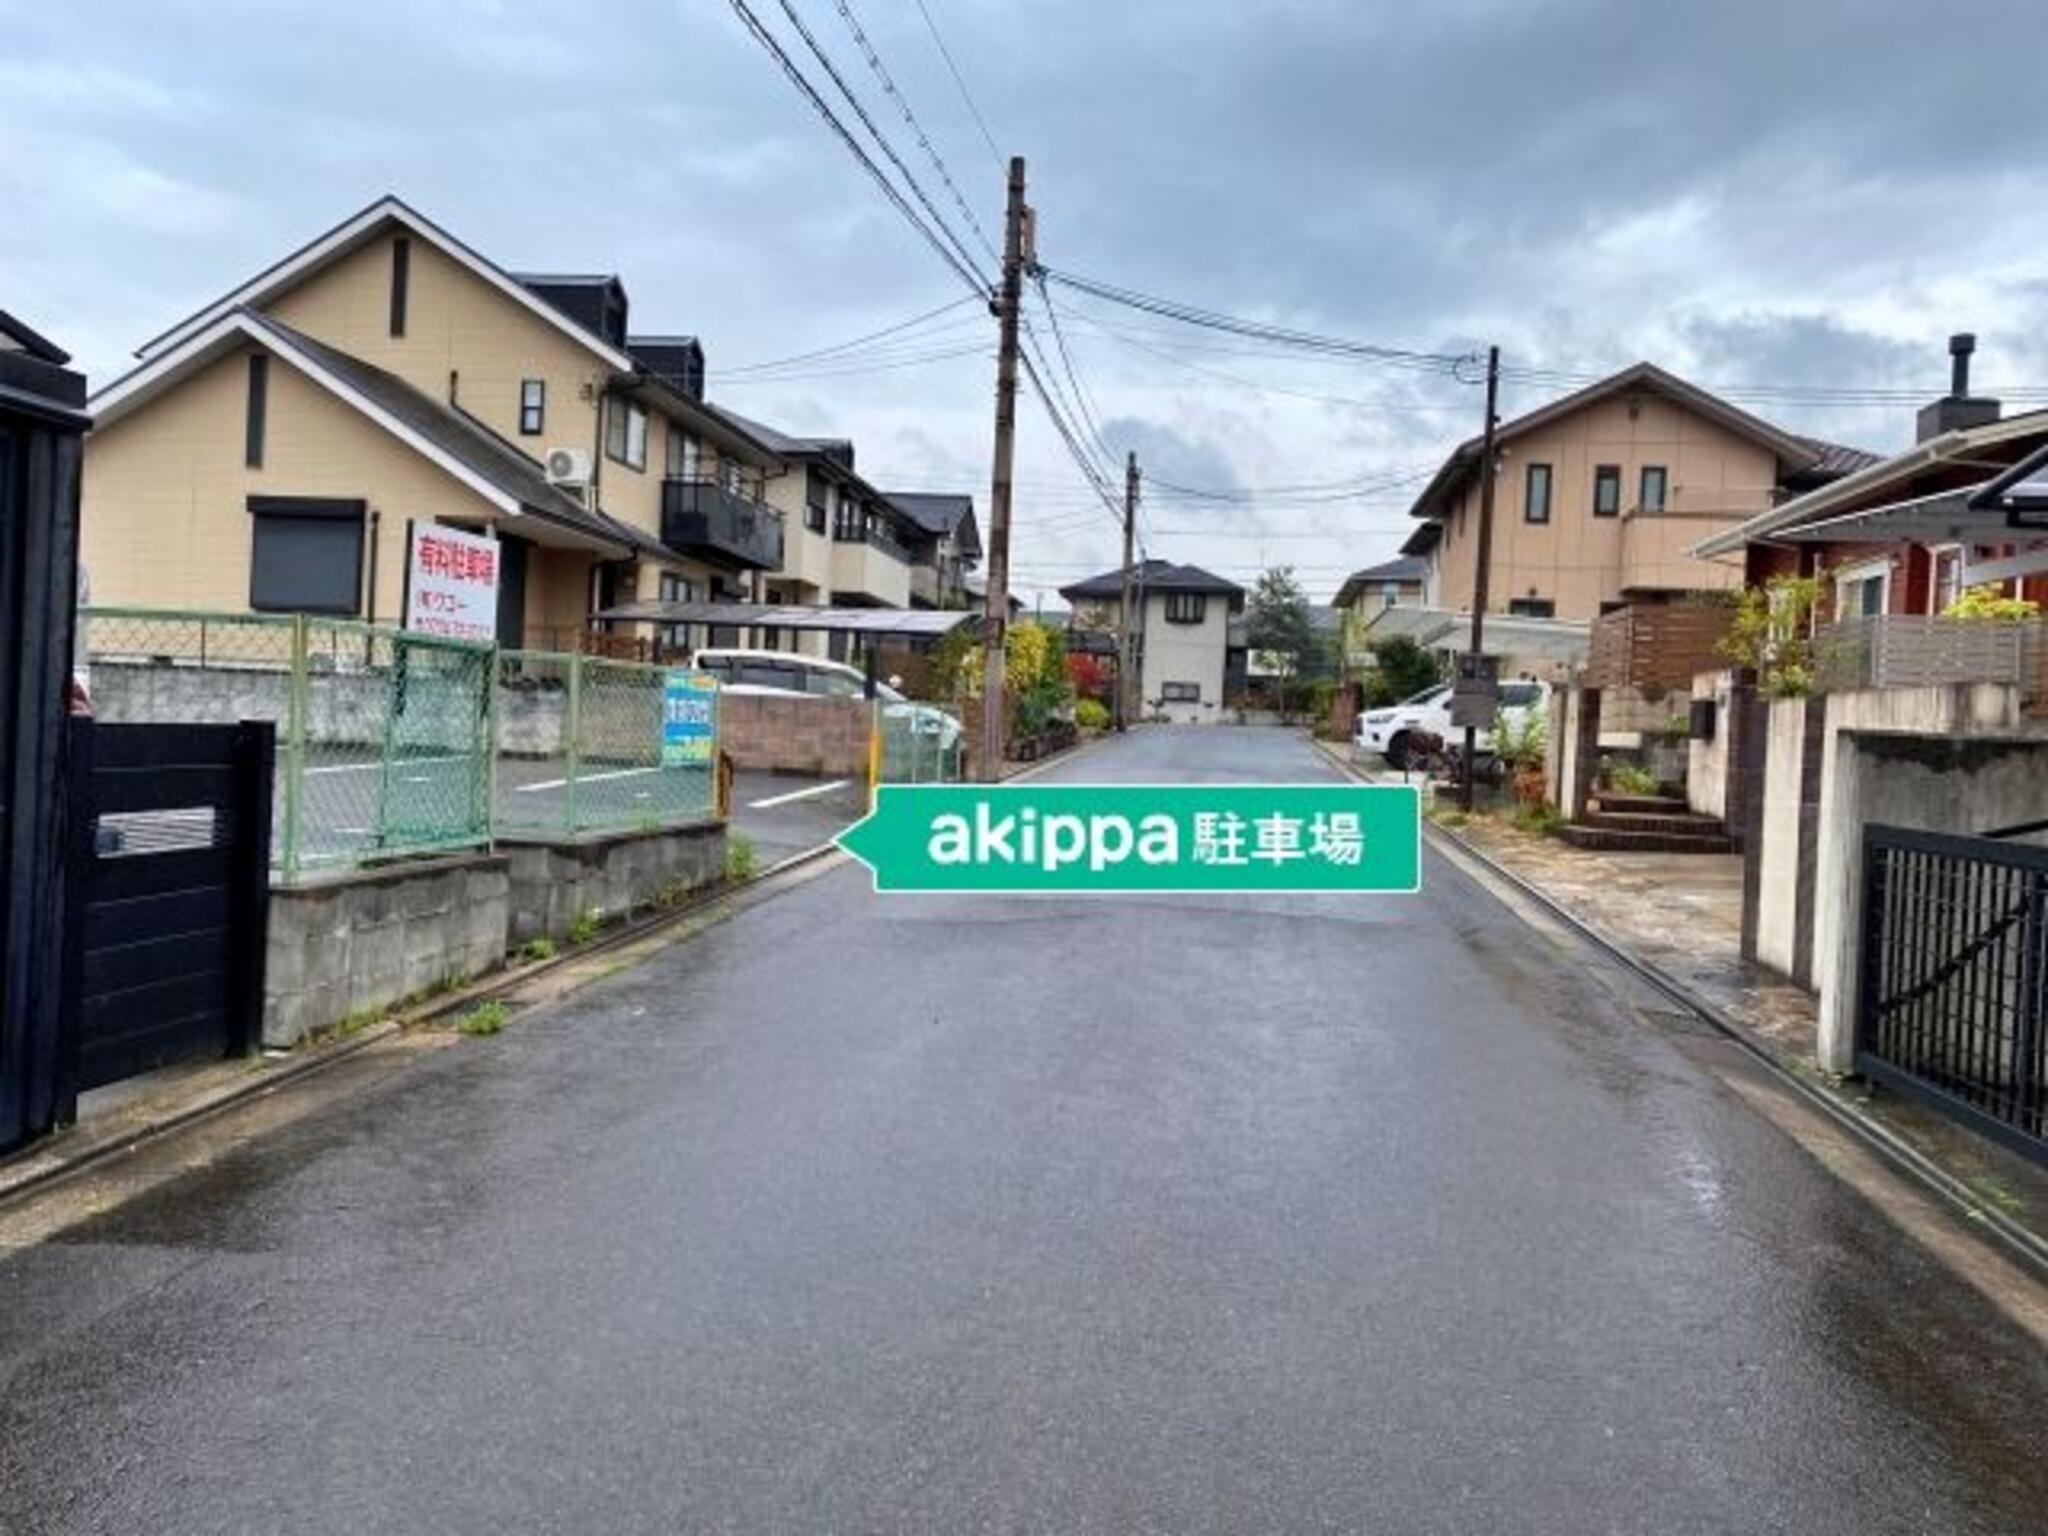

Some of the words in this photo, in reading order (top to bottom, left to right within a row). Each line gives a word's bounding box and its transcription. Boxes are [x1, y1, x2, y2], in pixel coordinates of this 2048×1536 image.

[418, 533, 495, 586] 有料駐車場
